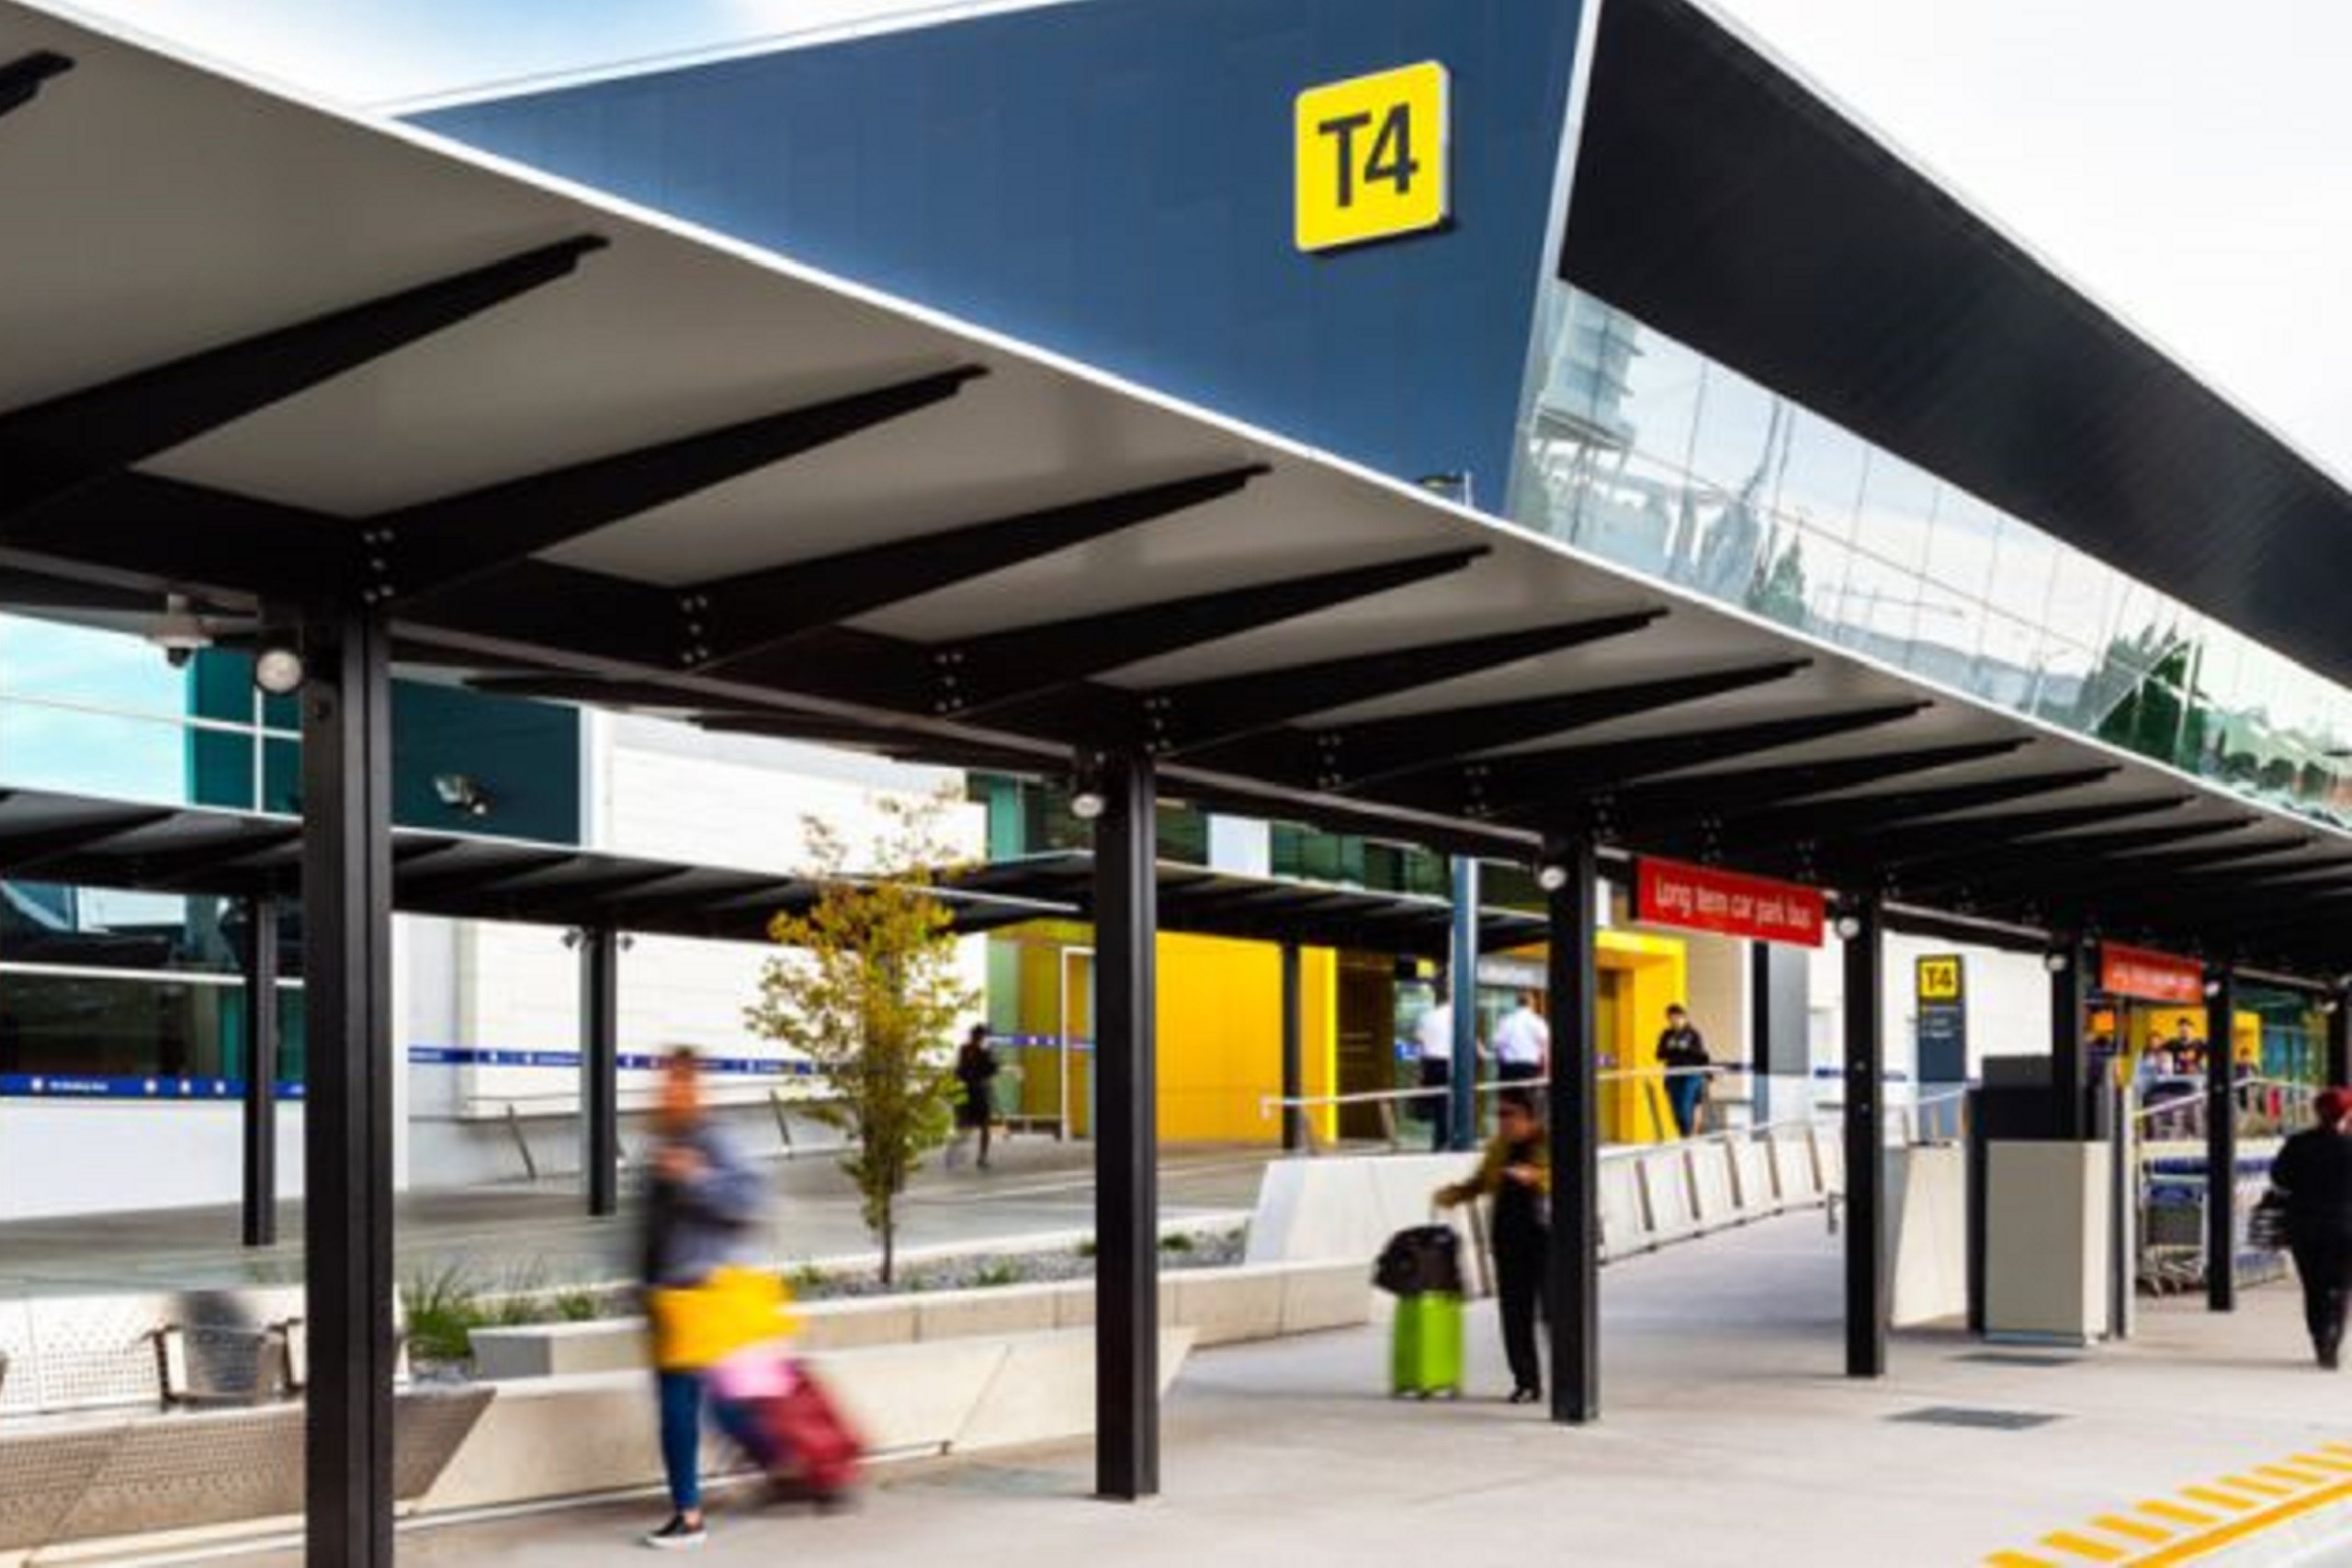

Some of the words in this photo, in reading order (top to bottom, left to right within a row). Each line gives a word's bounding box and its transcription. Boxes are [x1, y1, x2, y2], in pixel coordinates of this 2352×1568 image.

[1318, 101, 1419, 209] T4
[1656, 875, 1692, 918] Long
[1731, 894, 1751, 919] car
[1756, 894, 1784, 927] park
[1787, 896, 1812, 931] bus
[1925, 966, 1952, 991] T4
